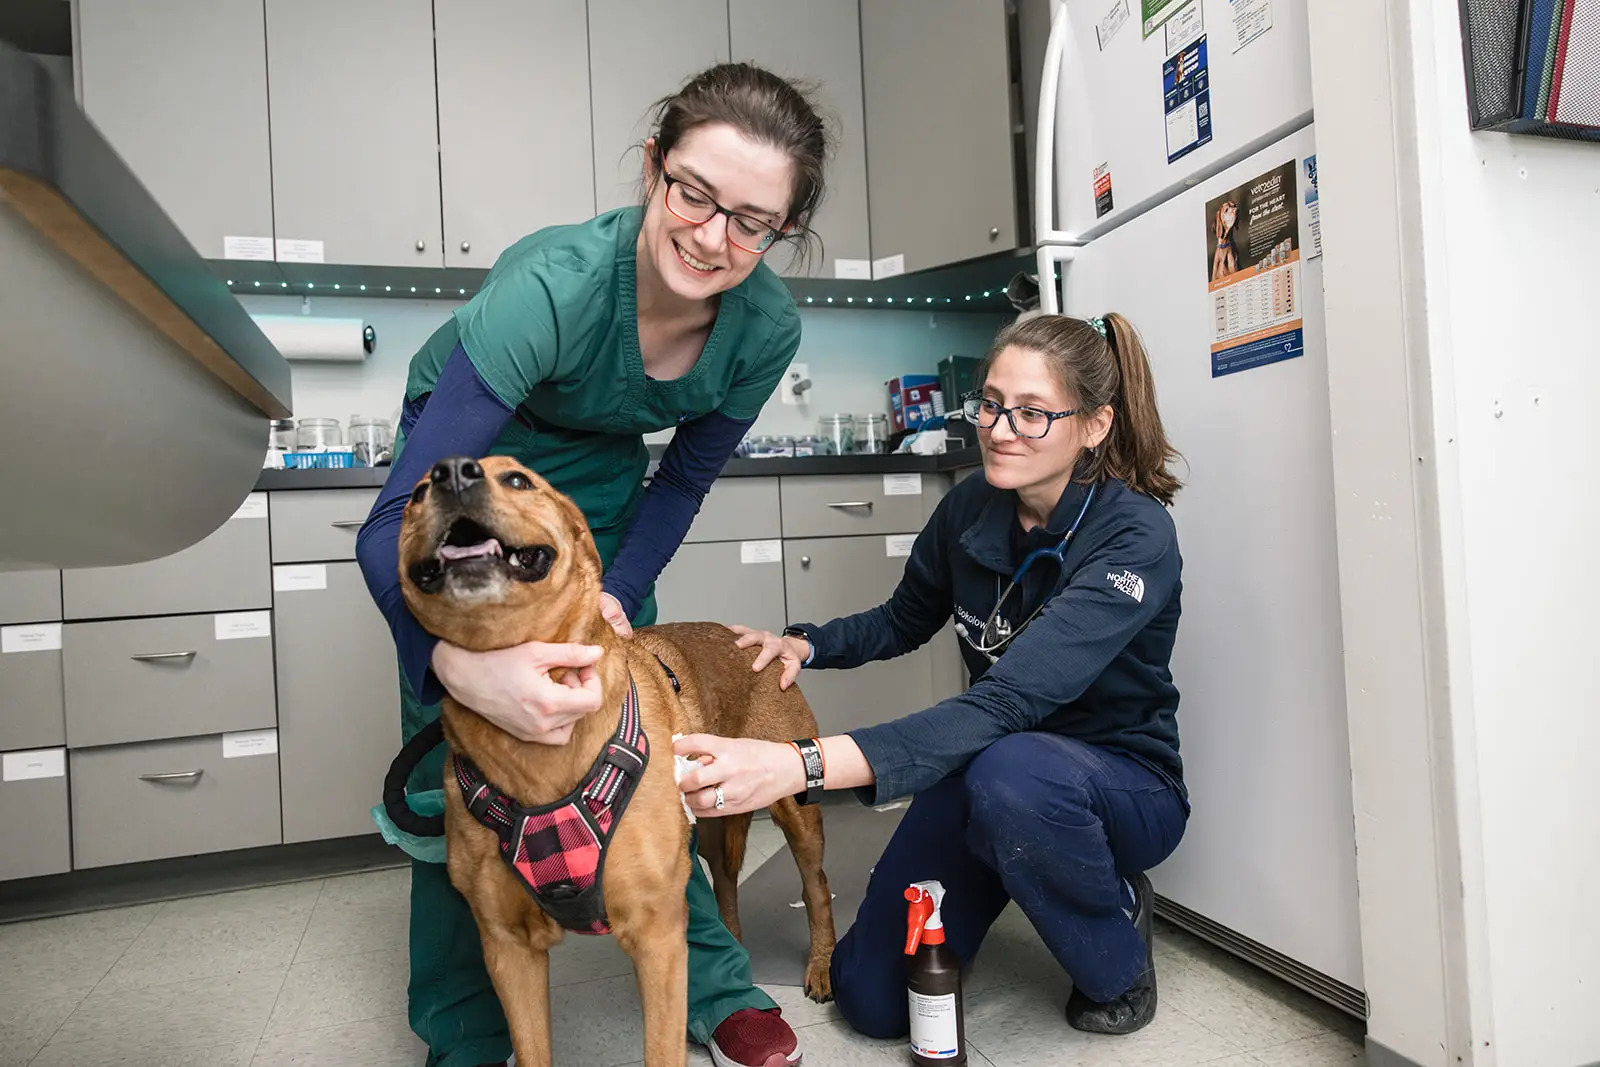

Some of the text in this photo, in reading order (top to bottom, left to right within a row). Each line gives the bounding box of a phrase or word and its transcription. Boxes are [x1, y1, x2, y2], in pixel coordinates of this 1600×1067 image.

[1249, 205, 1259, 214] FOR
[1260, 201, 1269, 210] THE
[1269, 194, 1285, 206] HEART
[1106, 572, 1137, 590] NORTH
[1123, 569, 1139, 582] THE
[1113, 581, 1133, 596] FACE
